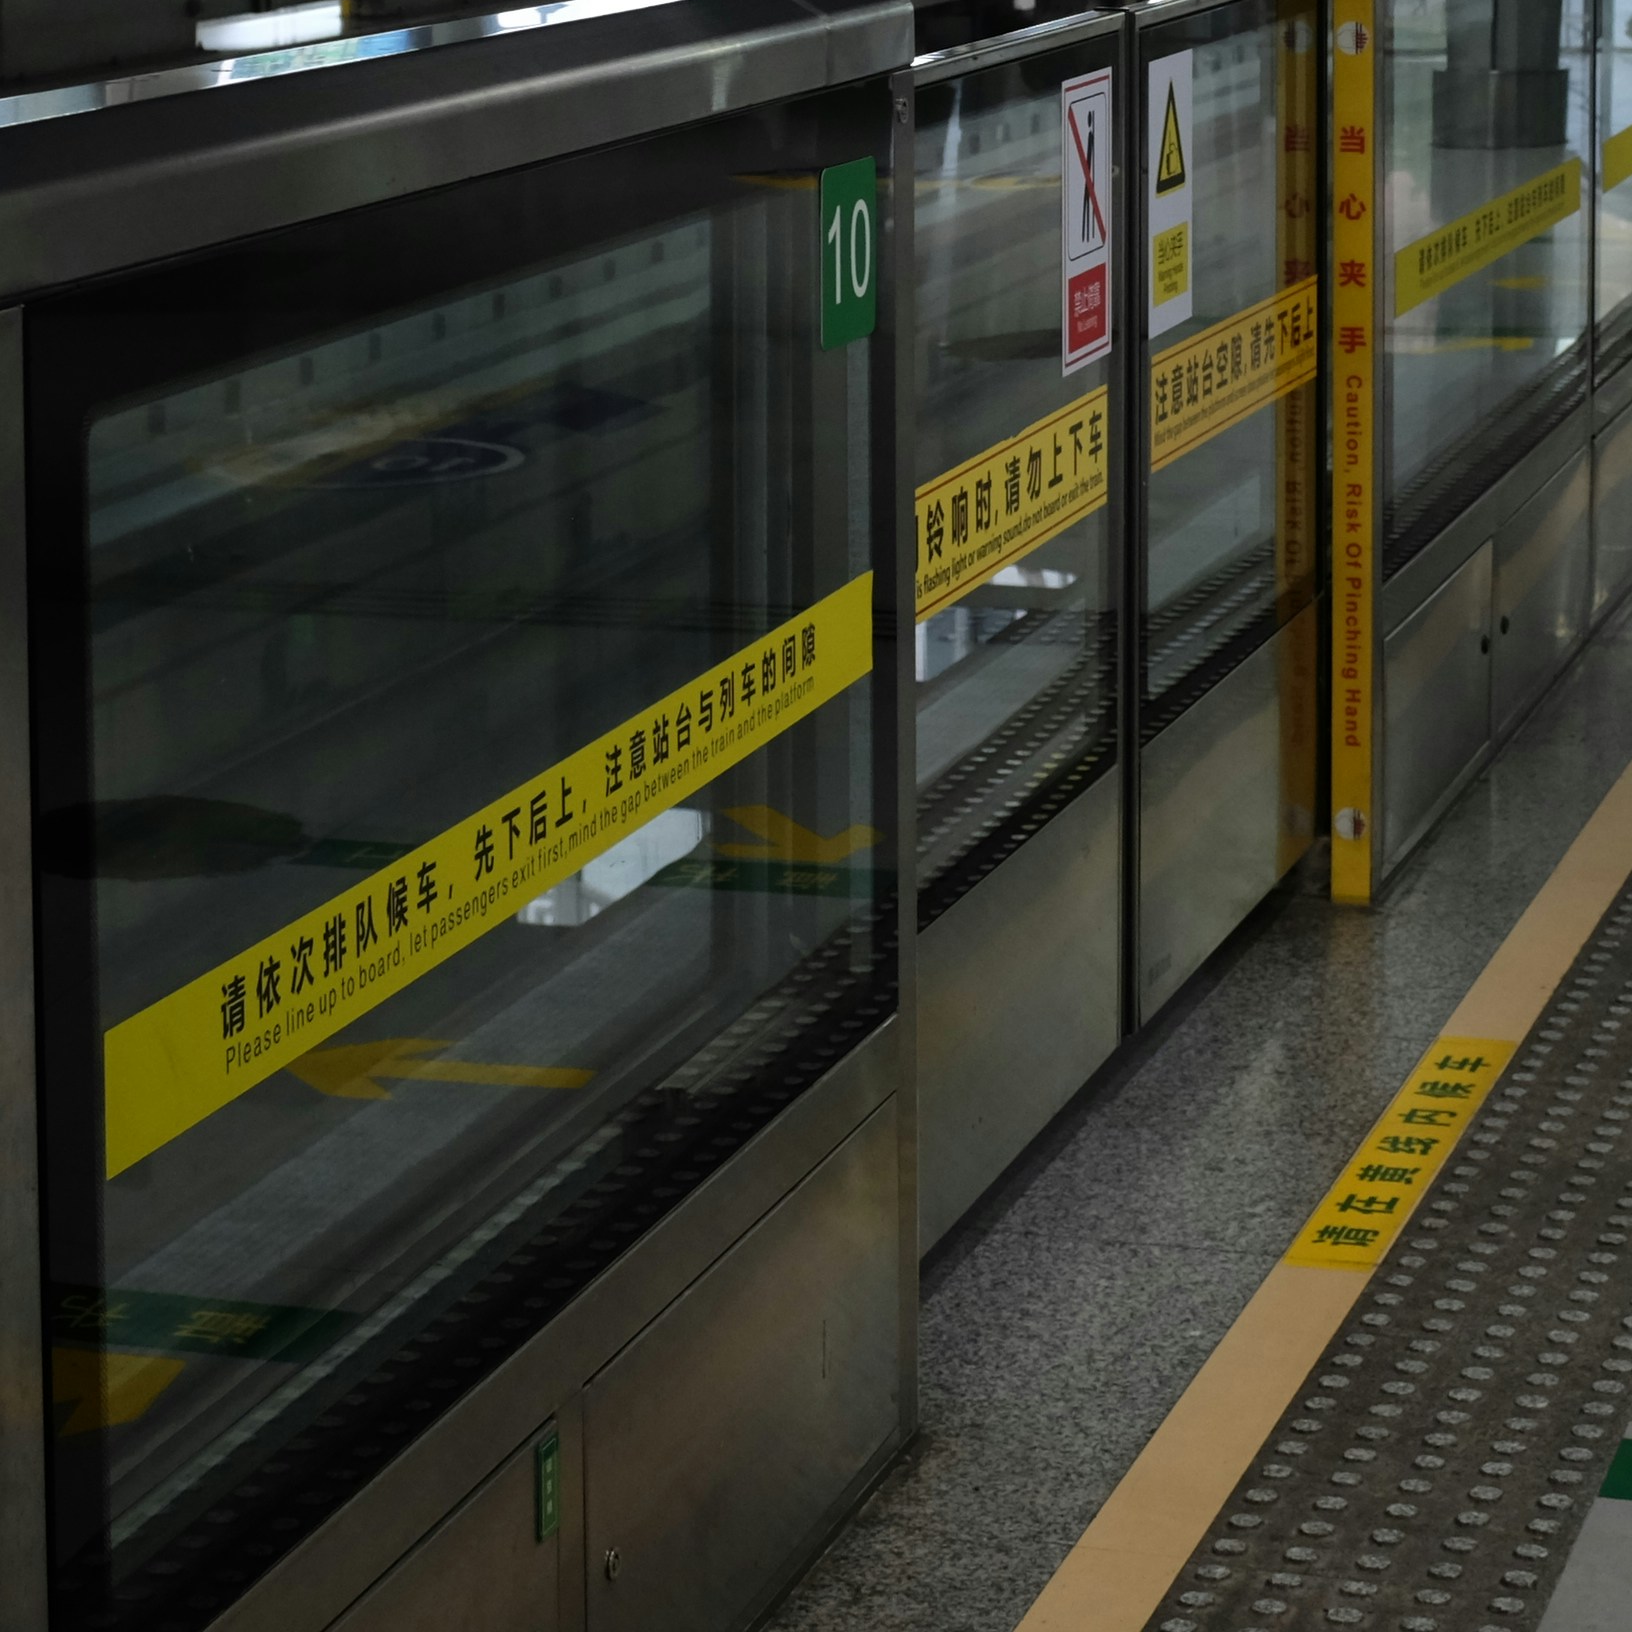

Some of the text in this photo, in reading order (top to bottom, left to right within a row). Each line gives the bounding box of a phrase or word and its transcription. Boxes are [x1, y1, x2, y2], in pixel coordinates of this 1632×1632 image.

[828, 198, 871, 305] 10
[1338, 125, 1367, 354] 当心夹手
[915, 410, 1103, 574] 铃响时，请勿上下车
[923, 565, 952, 595] flashing
[951, 552, 968, 582] light
[968, 549, 976, 567] or
[976, 534, 1002, 562] warning
[1032, 508, 1043, 530] not
[1341, 374, 1363, 747] Caution, Risk Of Pinching Hand
[225, 1022, 281, 1074] Please
[285, 1000, 316, 1037] line
[318, 990, 338, 1016] up
[341, 975, 355, 1001] to
[358, 940, 406, 989] board,
[409, 924, 428, 957] let
[431, 875, 509, 949] passengers
[511, 856, 536, 889] exit
[599, 805, 618, 831] the
[620, 789, 642, 824] gap
[643, 757, 690, 803] between
[692, 746, 709, 771] the
[710, 728, 735, 758] train
[737, 713, 755, 740] and
[757, 703, 773, 729] the
[774, 675, 815, 721] platform
[1311, 1054, 1491, 1247] 请在黄线内候车
